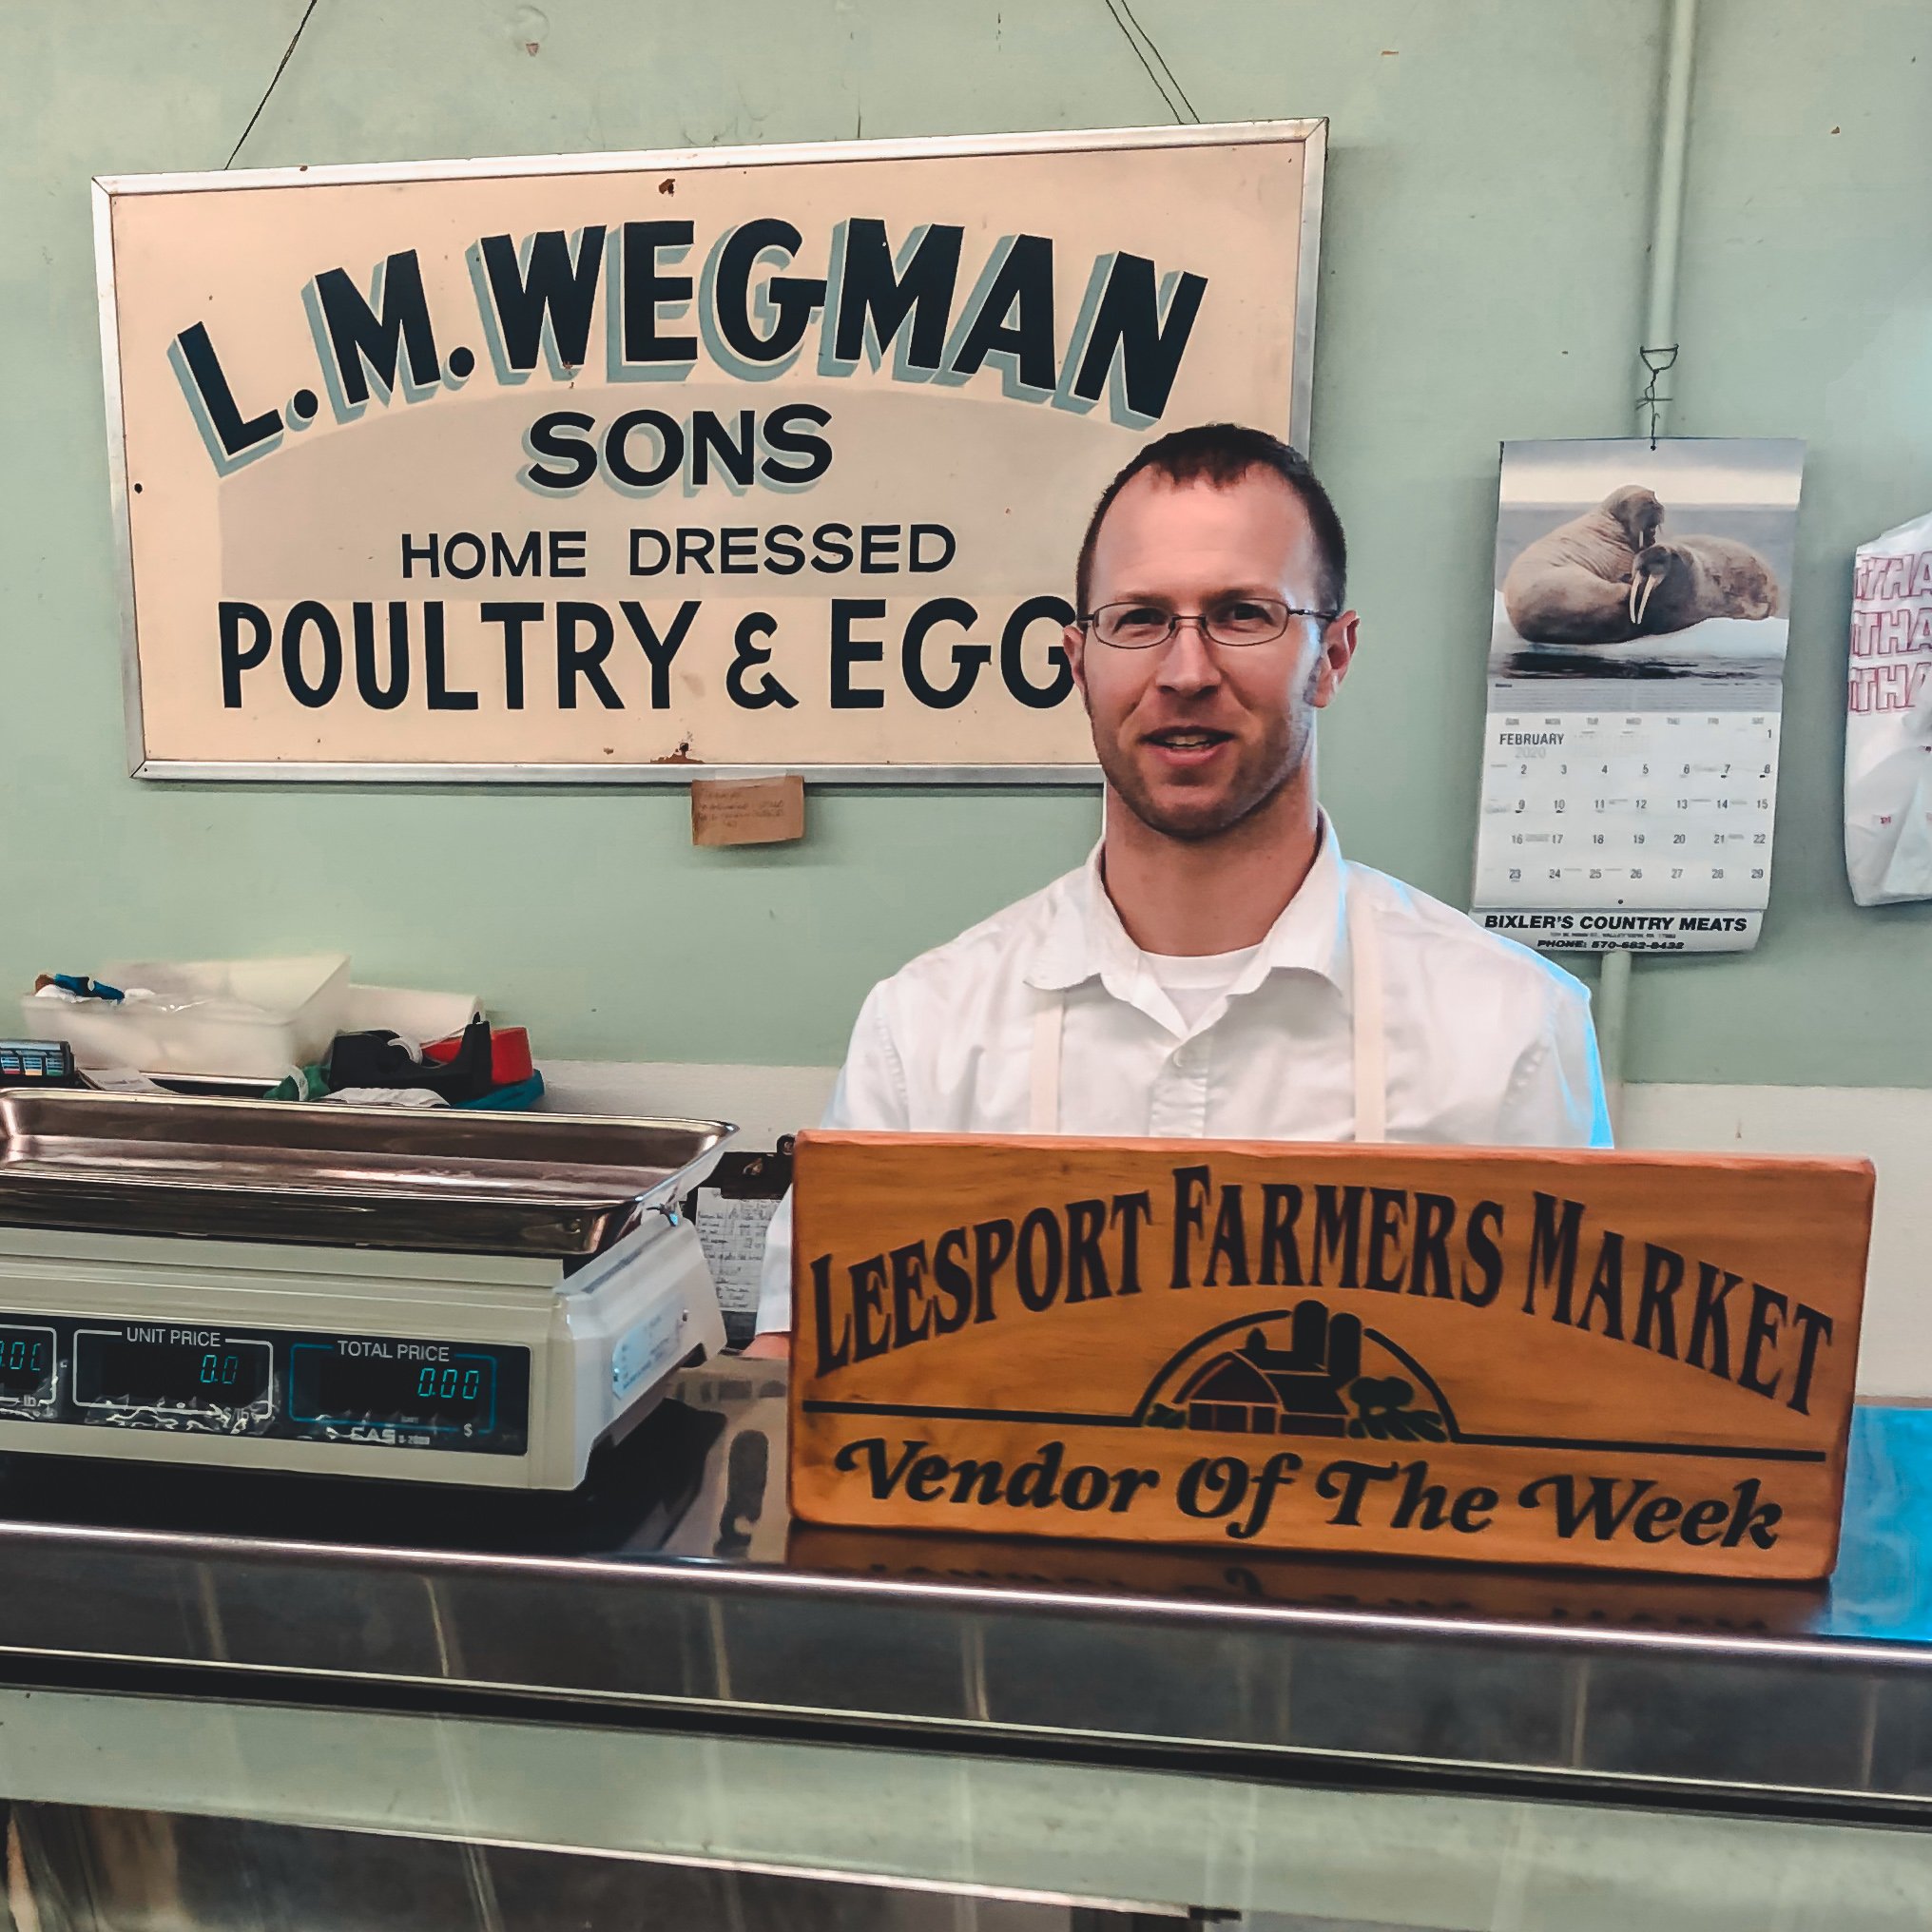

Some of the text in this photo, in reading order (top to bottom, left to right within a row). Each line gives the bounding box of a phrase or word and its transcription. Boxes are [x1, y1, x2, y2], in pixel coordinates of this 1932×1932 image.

[521, 404, 833, 491] SONS
[402, 523, 956, 579] HOME DRESSED
[219, 599, 702, 710] POULTRY
[725, 611, 800, 709] &
[1499, 733, 1564, 745] FEBRUARY
[1767, 729, 1772, 739] 1
[1515, 746, 1546, 759] 2020
[1520, 763, 1771, 775] 2 3 4 5 6 7 8
[1518, 799, 1768, 810] 9 10 11 12 13 14 15
[1512, 833, 1766, 845] 16 17 18 19 20 21 22
[1509, 868, 1764, 879] 23 24 25 26 27 28 29
[1484, 915, 1747, 932] BIXLER'S COUNTRY MEATS
[810, 1190, 1151, 1379] LEESPORT
[1169, 1164, 1504, 1308] FARMERS
[1521, 1190, 1833, 1416] MARKET
[126, 1326, 222, 1347] UNIT PRICE
[338, 1340, 450, 1362] TOTAL PRICE
[200, 1354, 238, 1384] 0.0
[417, 1367, 479, 1400] 0.00
[835, 1438, 1783, 1551] Vendor Of The Week
